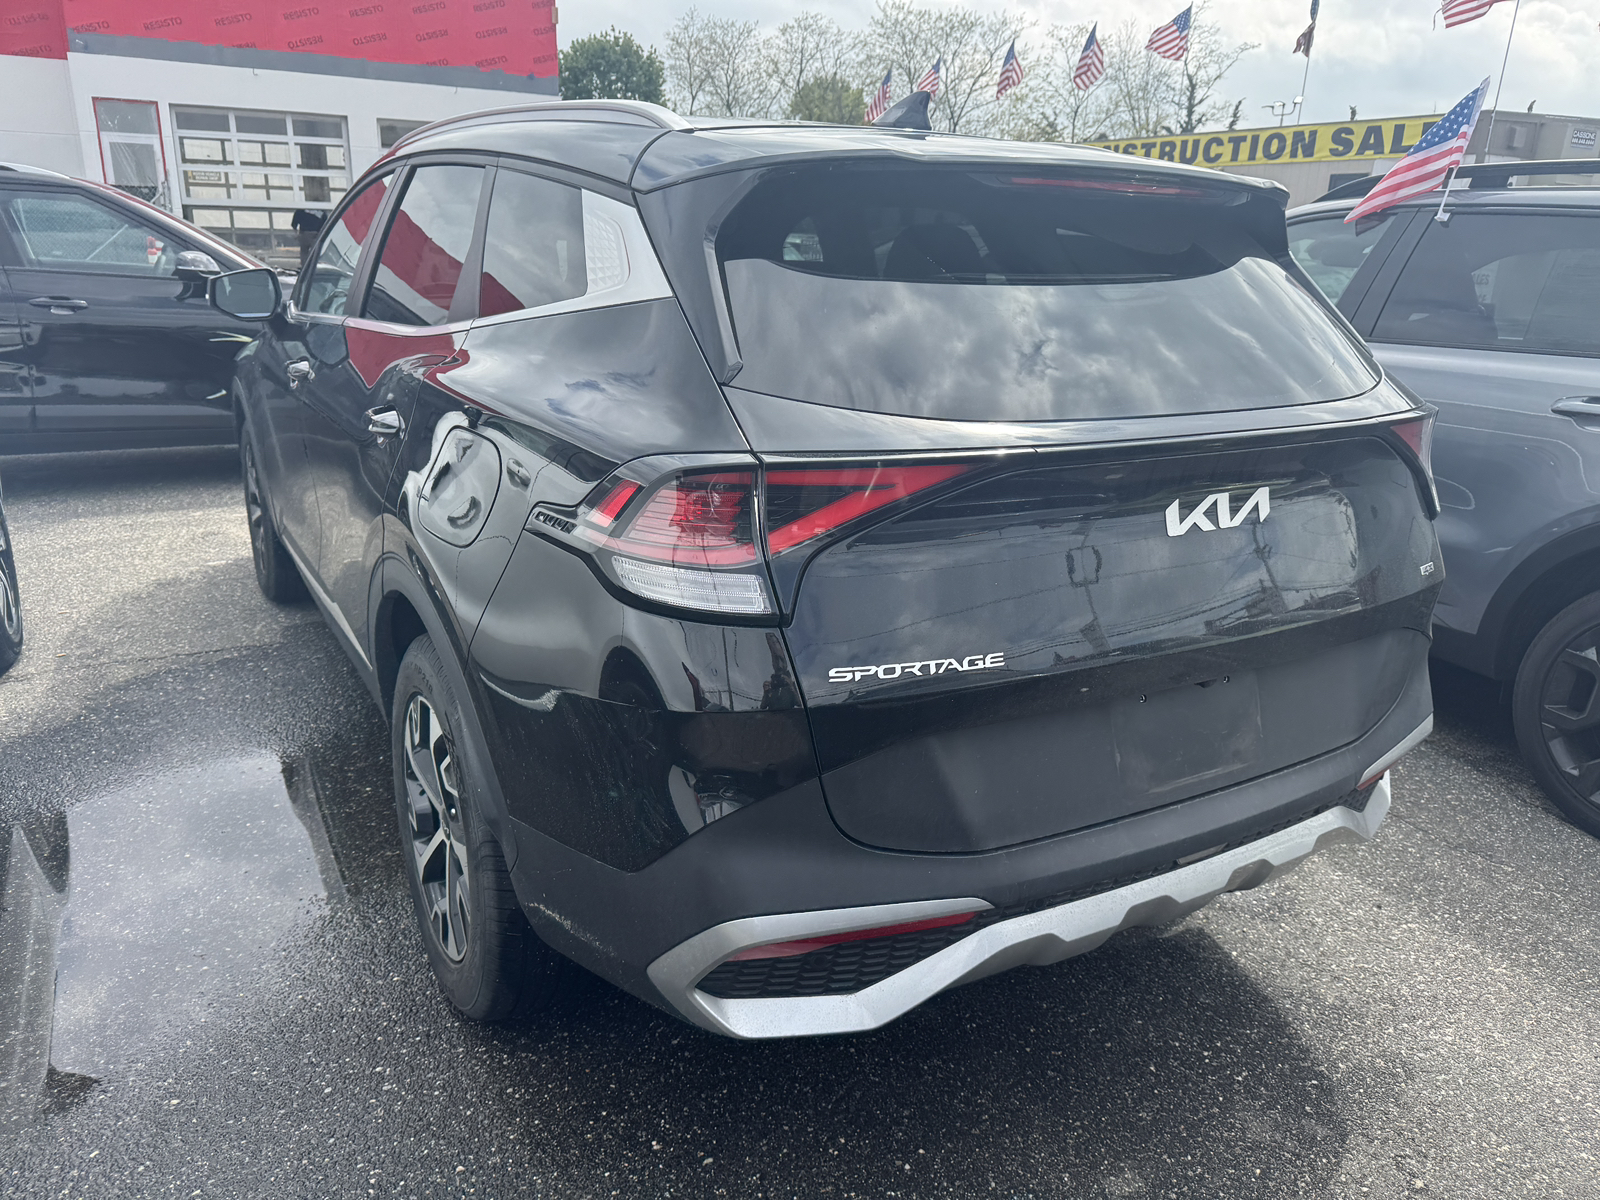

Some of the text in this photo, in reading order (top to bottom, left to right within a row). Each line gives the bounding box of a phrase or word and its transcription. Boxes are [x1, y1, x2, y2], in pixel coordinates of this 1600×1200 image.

[283, 7, 319, 21] RESISTO
[349, 4, 384, 18] RESISTO
[412, 1, 446, 15] RESISTO
[473, 1, 506, 13] RESISTO
[142, 16, 183, 31] RESISTO
[214, 12, 253, 27] RESISTO
[287, 34, 324, 50] RESISTO
[352, 32, 388, 46] RESISTO
[415, 28, 449, 42] RESISTO
[1165, 486, 1270, 537] KIA
[828, 652, 1006, 683] SPORTAGE
